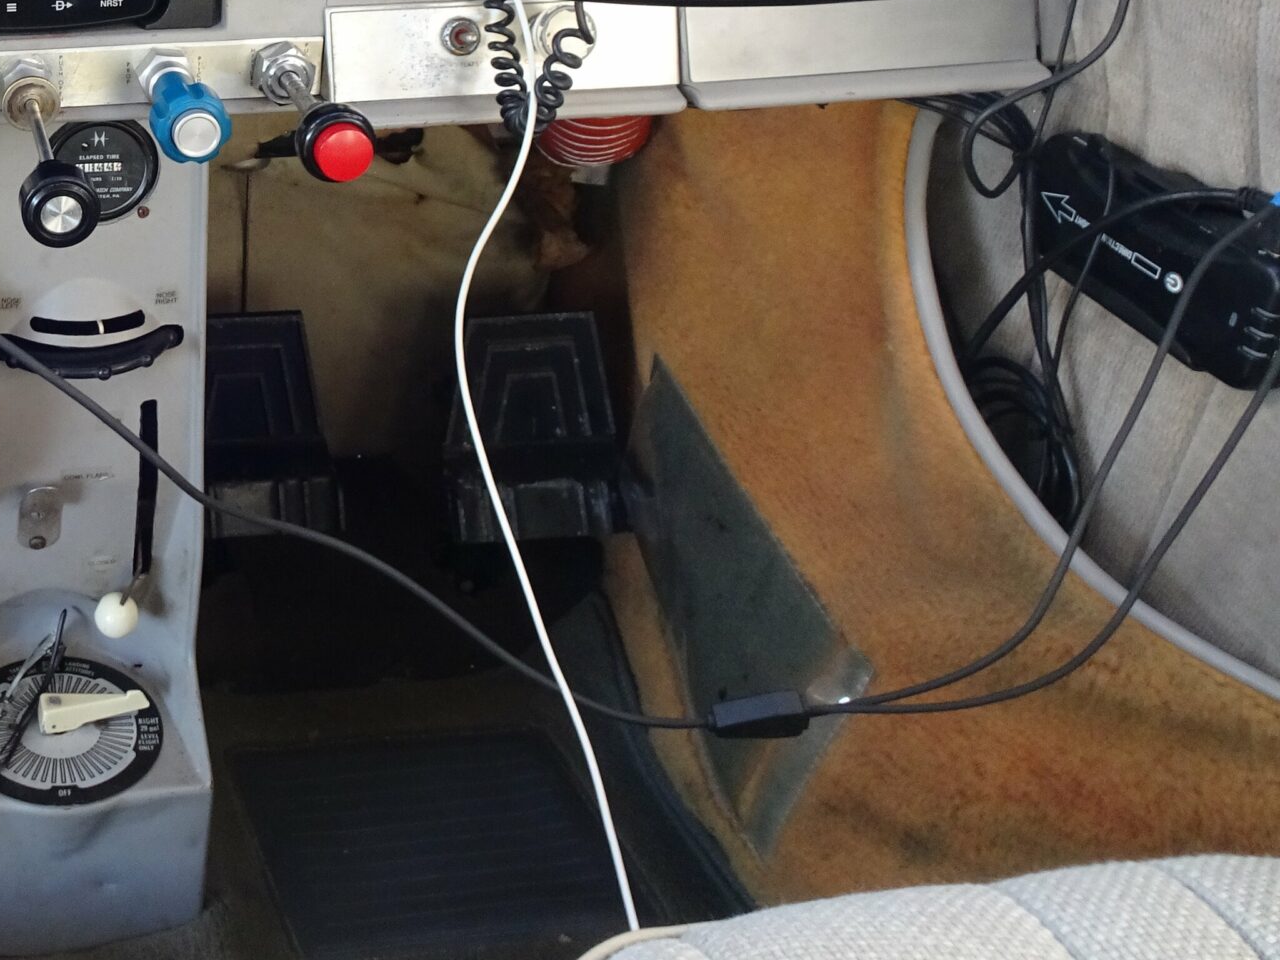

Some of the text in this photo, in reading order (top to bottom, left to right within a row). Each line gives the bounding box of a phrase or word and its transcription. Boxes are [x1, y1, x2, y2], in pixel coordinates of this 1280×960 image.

[100, 0, 124, 8] NRST
[138, 717, 159, 725] RIGHT
[58, 789, 71, 797] OFF
